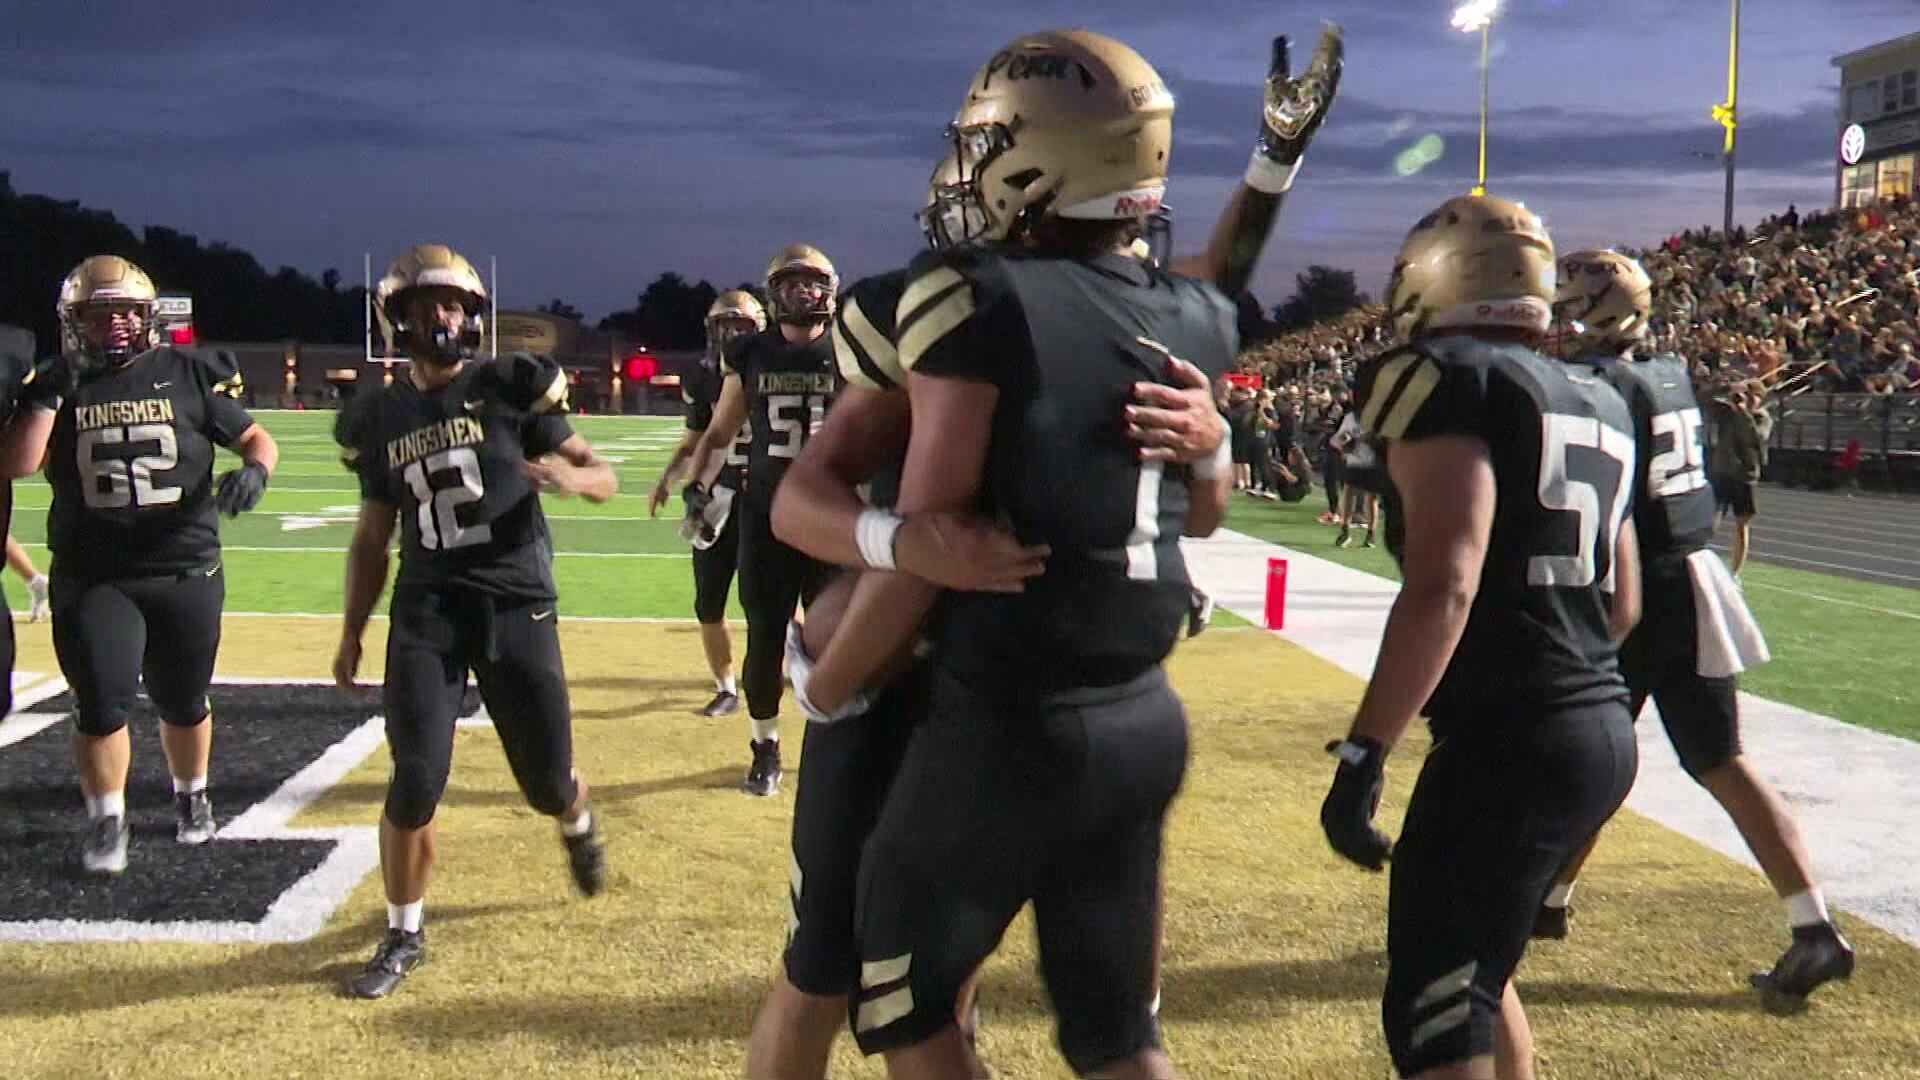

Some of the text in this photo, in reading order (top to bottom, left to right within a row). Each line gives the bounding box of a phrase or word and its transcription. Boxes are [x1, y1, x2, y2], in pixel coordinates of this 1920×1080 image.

[75, 399, 174, 430] KINGSMEN
[387, 417, 485, 469] KINGSMEN
[1647, 409, 1707, 497] 25
[76, 425, 183, 507] 62
[404, 448, 492, 550] 12
[1527, 413, 1635, 592] 57
